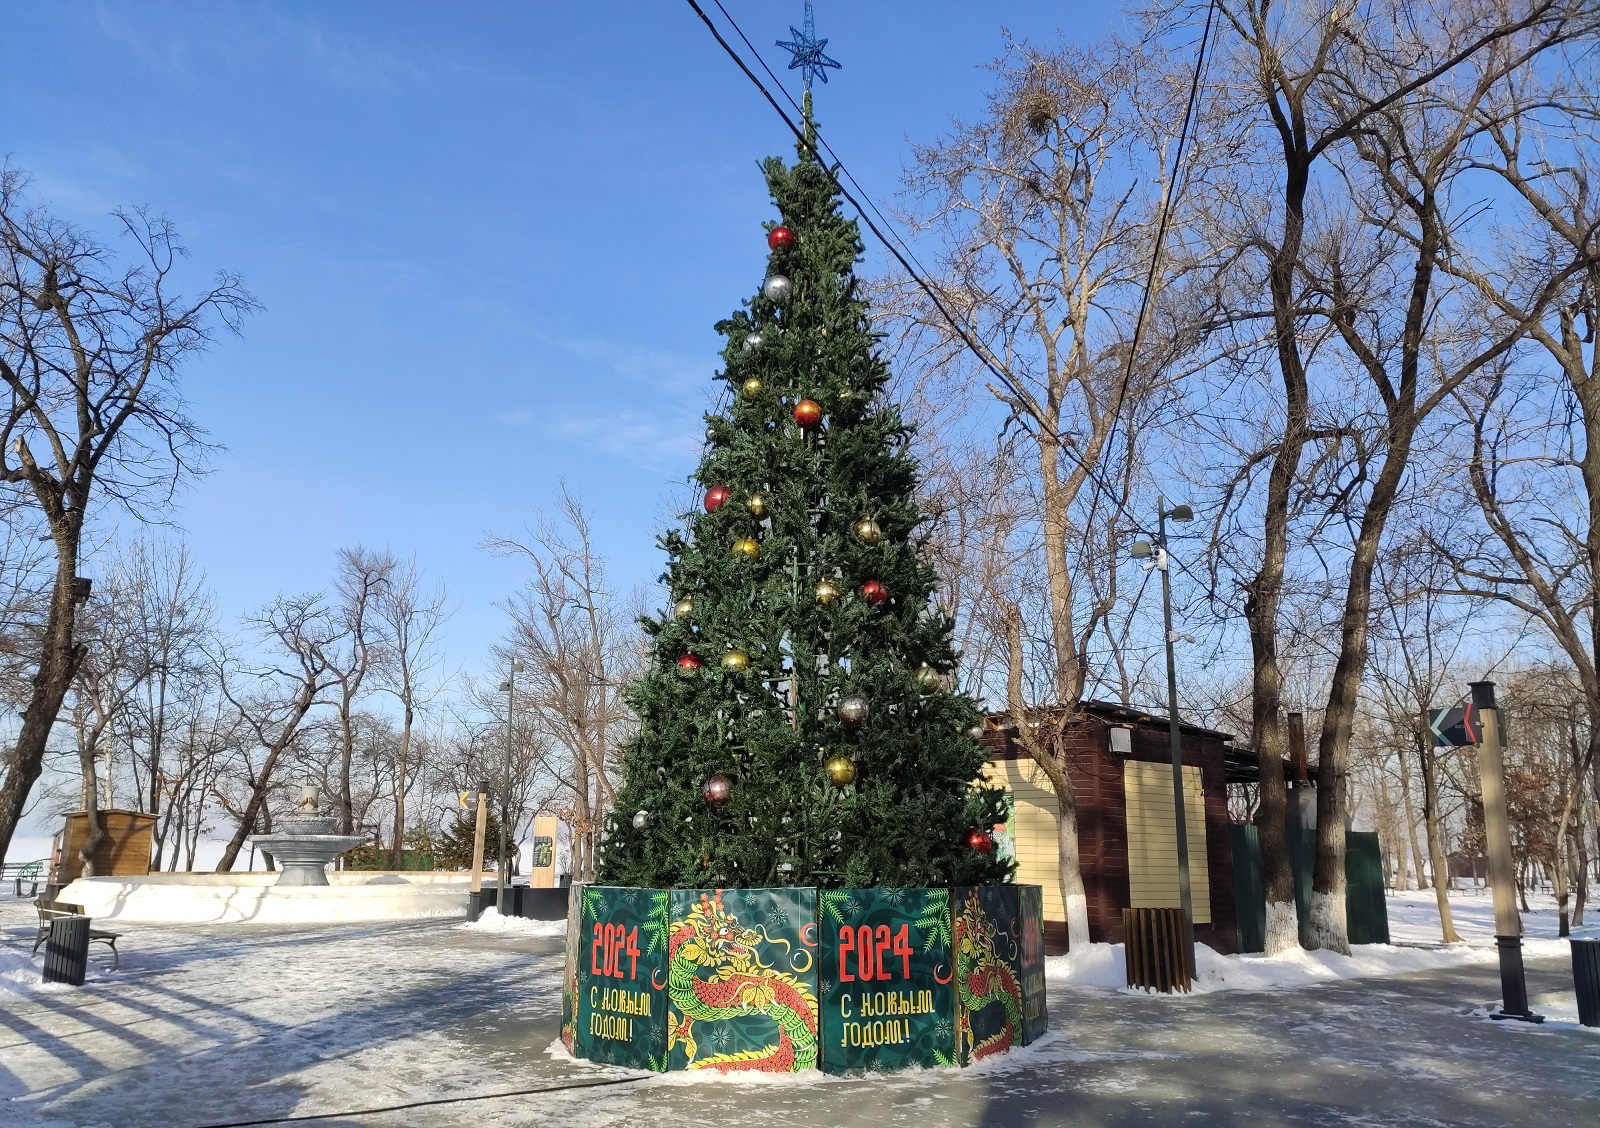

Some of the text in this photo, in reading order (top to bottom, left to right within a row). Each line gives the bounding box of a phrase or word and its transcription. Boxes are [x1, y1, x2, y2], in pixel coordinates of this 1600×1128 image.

[591, 921, 641, 980] 2024
[839, 923, 914, 983] 2024
[590, 985, 598, 1009] С
[841, 993, 852, 1019] С
